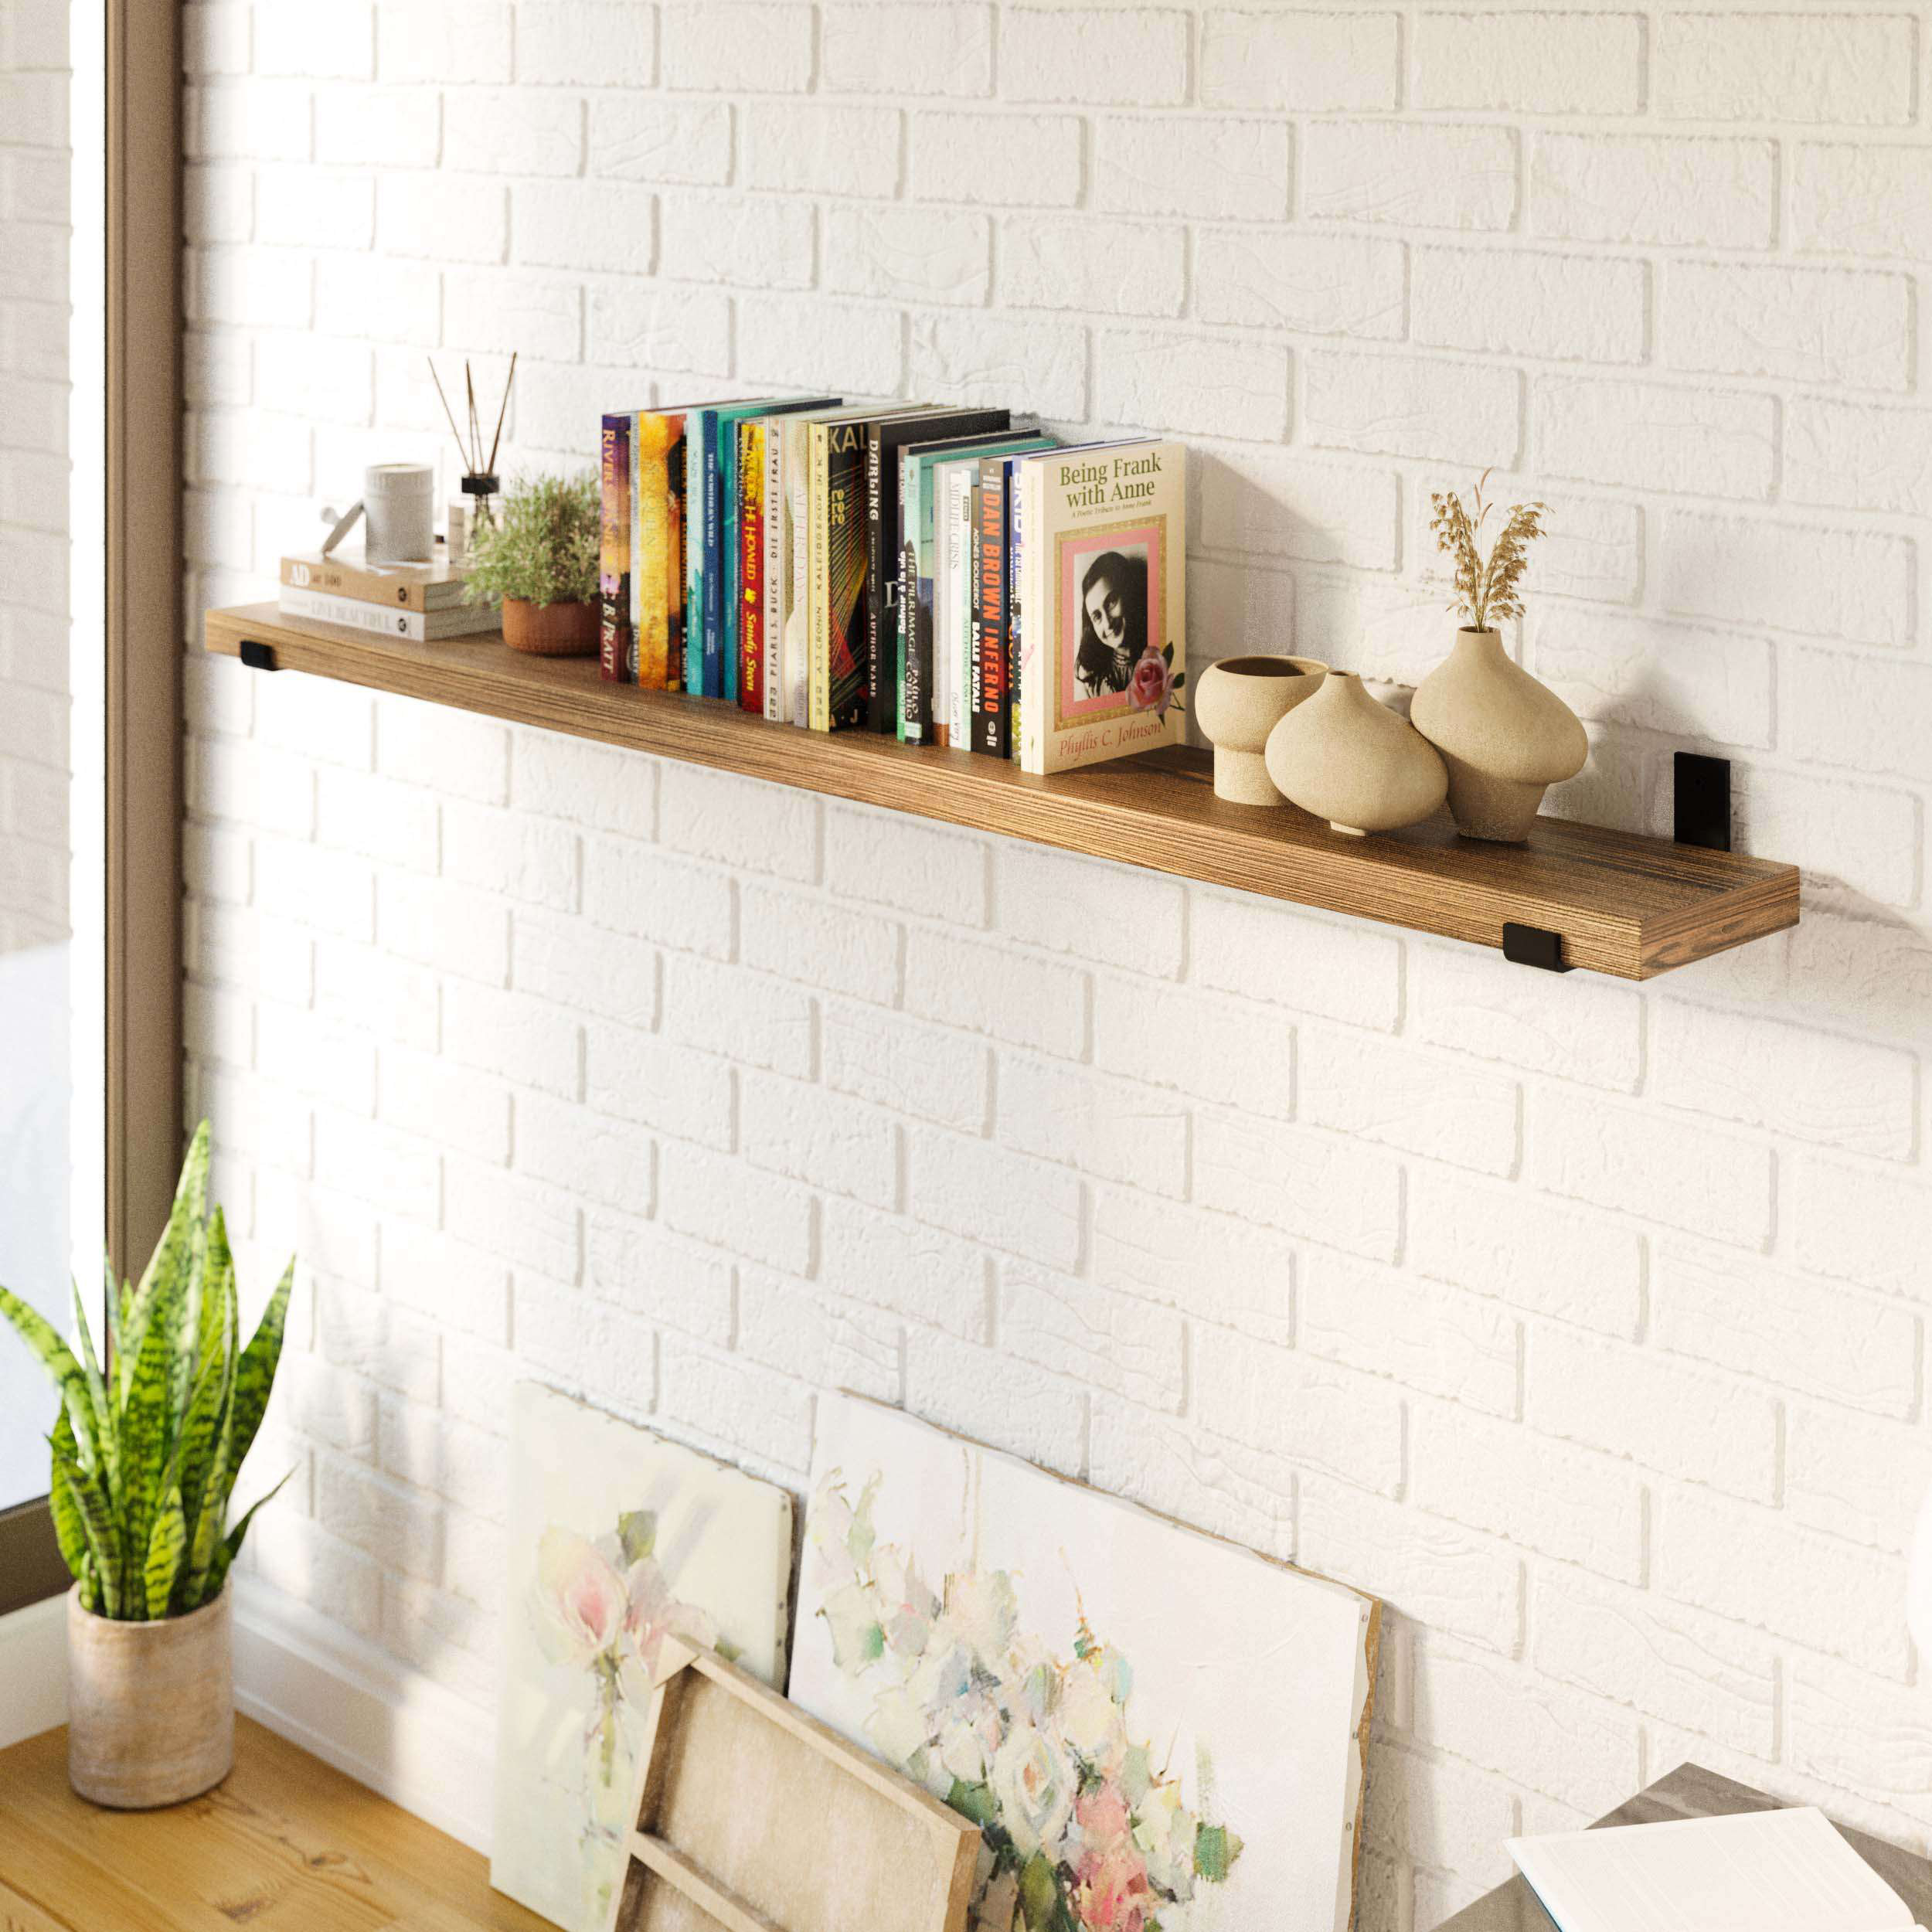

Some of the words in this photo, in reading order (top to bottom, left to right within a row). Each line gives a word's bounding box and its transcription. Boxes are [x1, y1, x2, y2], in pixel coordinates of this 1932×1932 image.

[770, 448, 779, 484] FRAU
[869, 440, 879, 521] DARLING
[1060, 462, 1107, 486] Being
[1114, 453, 1162, 478] Frank
[982, 493, 1002, 537] DAN
[1066, 485, 1105, 508] with
[1111, 481, 1155, 502] Anne
[745, 526, 757, 580] HOWLED
[907, 552, 916, 577] THE
[770, 578, 778, 614] BUCK
[982, 543, 1002, 621] BROWN
[603, 621, 617, 674] PRATT
[744, 612, 757, 654] Sandy
[971, 622, 981, 662] BALLE
[971, 665, 981, 713] FATALE
[984, 628, 1000, 713] INFERNO
[1060, 730, 1097, 760] Phyllis
[1100, 730, 1113, 746] C.
[1118, 721, 1161, 747] Johnson
